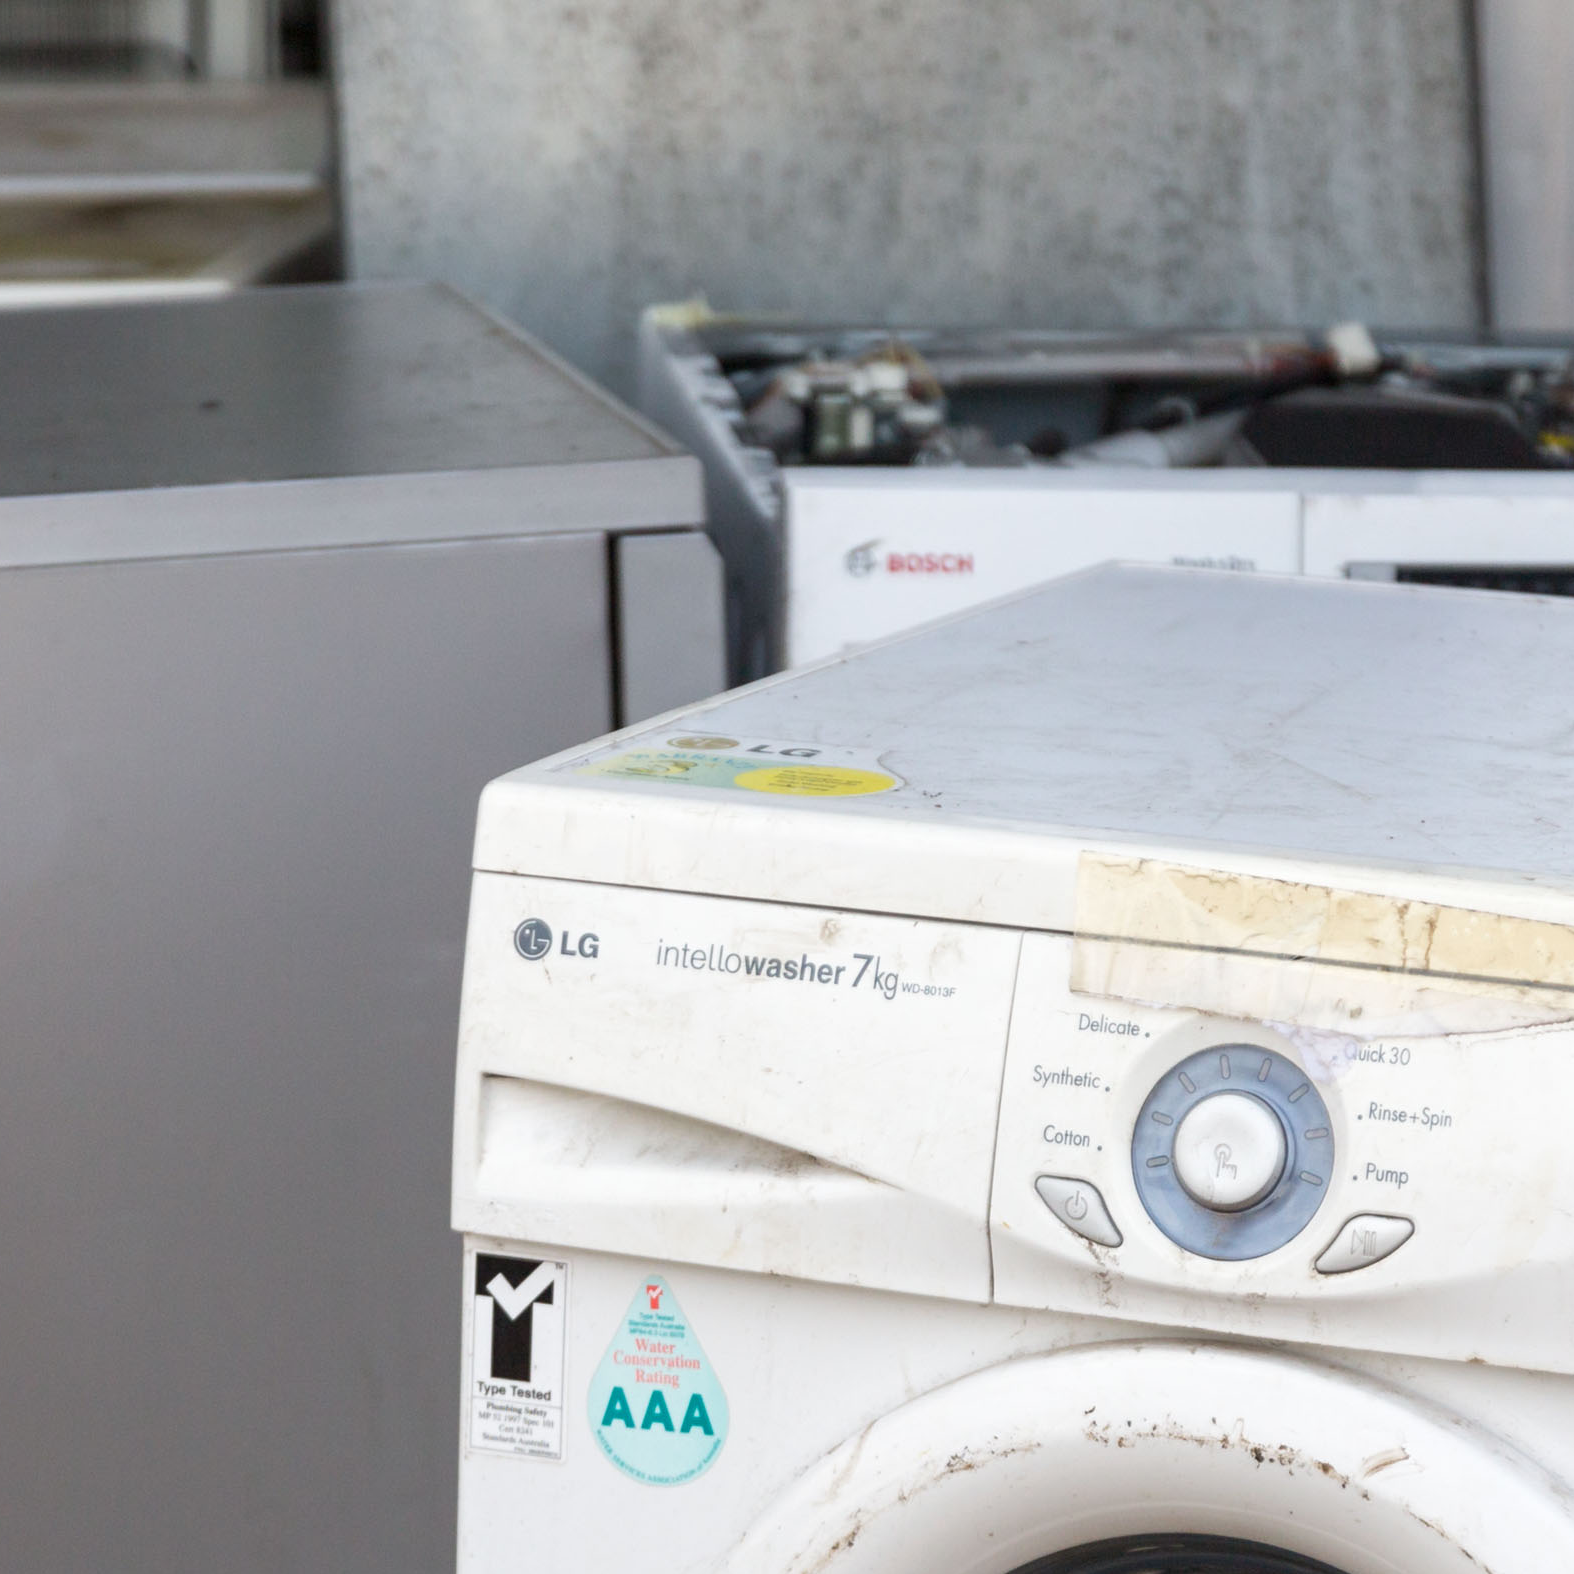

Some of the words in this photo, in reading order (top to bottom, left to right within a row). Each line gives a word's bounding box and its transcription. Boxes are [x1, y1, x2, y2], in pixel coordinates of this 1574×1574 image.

[886, 552, 973, 574] BOSCH
[745, 744, 823, 758] LG
[560, 930, 600, 959] LG
[657, 938, 846, 986] intellowasher
[901, 980, 957, 998] WD-8013F
[1078, 1013, 1140, 1036] Delicate
[1345, 1041, 1386, 1063] Quick
[1389, 1046, 1411, 1065] 30
[1033, 1064, 1101, 1088] Synthetic
[1043, 1124, 1090, 1147] Cotton
[1365, 1163, 1409, 1189] Pump
[635, 1338, 676, 1354] Water
[613, 1350, 701, 1369] Conservation
[635, 1368, 680, 1388] Rating
[477, 1381, 506, 1396] Type
[510, 1385, 551, 1401] Tested
[487, 1401, 522, 1415] Plumbing
[525, 1407, 547, 1417] Safety
[601, 1386, 714, 1436] AAA
[482, 1432, 516, 1443] Standards
[518, 1438, 550, 1448] Australia
